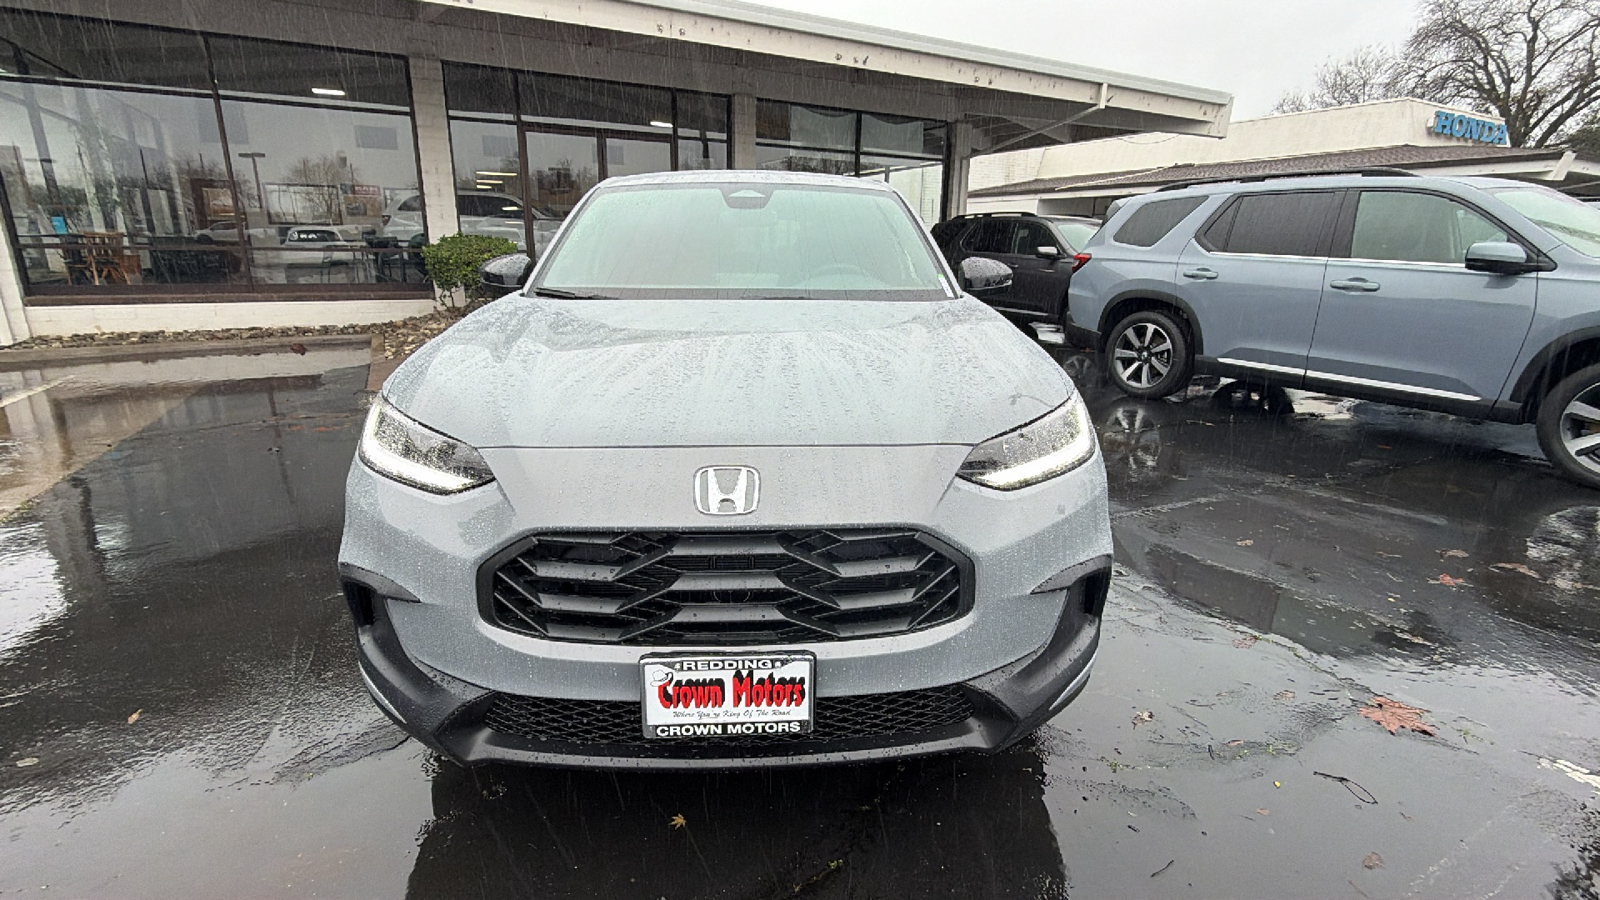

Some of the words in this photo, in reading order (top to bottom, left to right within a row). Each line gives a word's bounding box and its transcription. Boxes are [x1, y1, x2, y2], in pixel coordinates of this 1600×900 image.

[1434, 110, 1507, 145] HONDA
[682, 659, 773, 671] REDDING
[658, 678, 725, 709] Crown
[732, 670, 806, 708] Motors
[723, 710, 741, 719] King
[743, 710, 753, 719] Of
[756, 709, 769, 717] The
[772, 709, 791, 717] Road
[656, 725, 722, 737] CROWN
[727, 722, 801, 735] MOTORS
